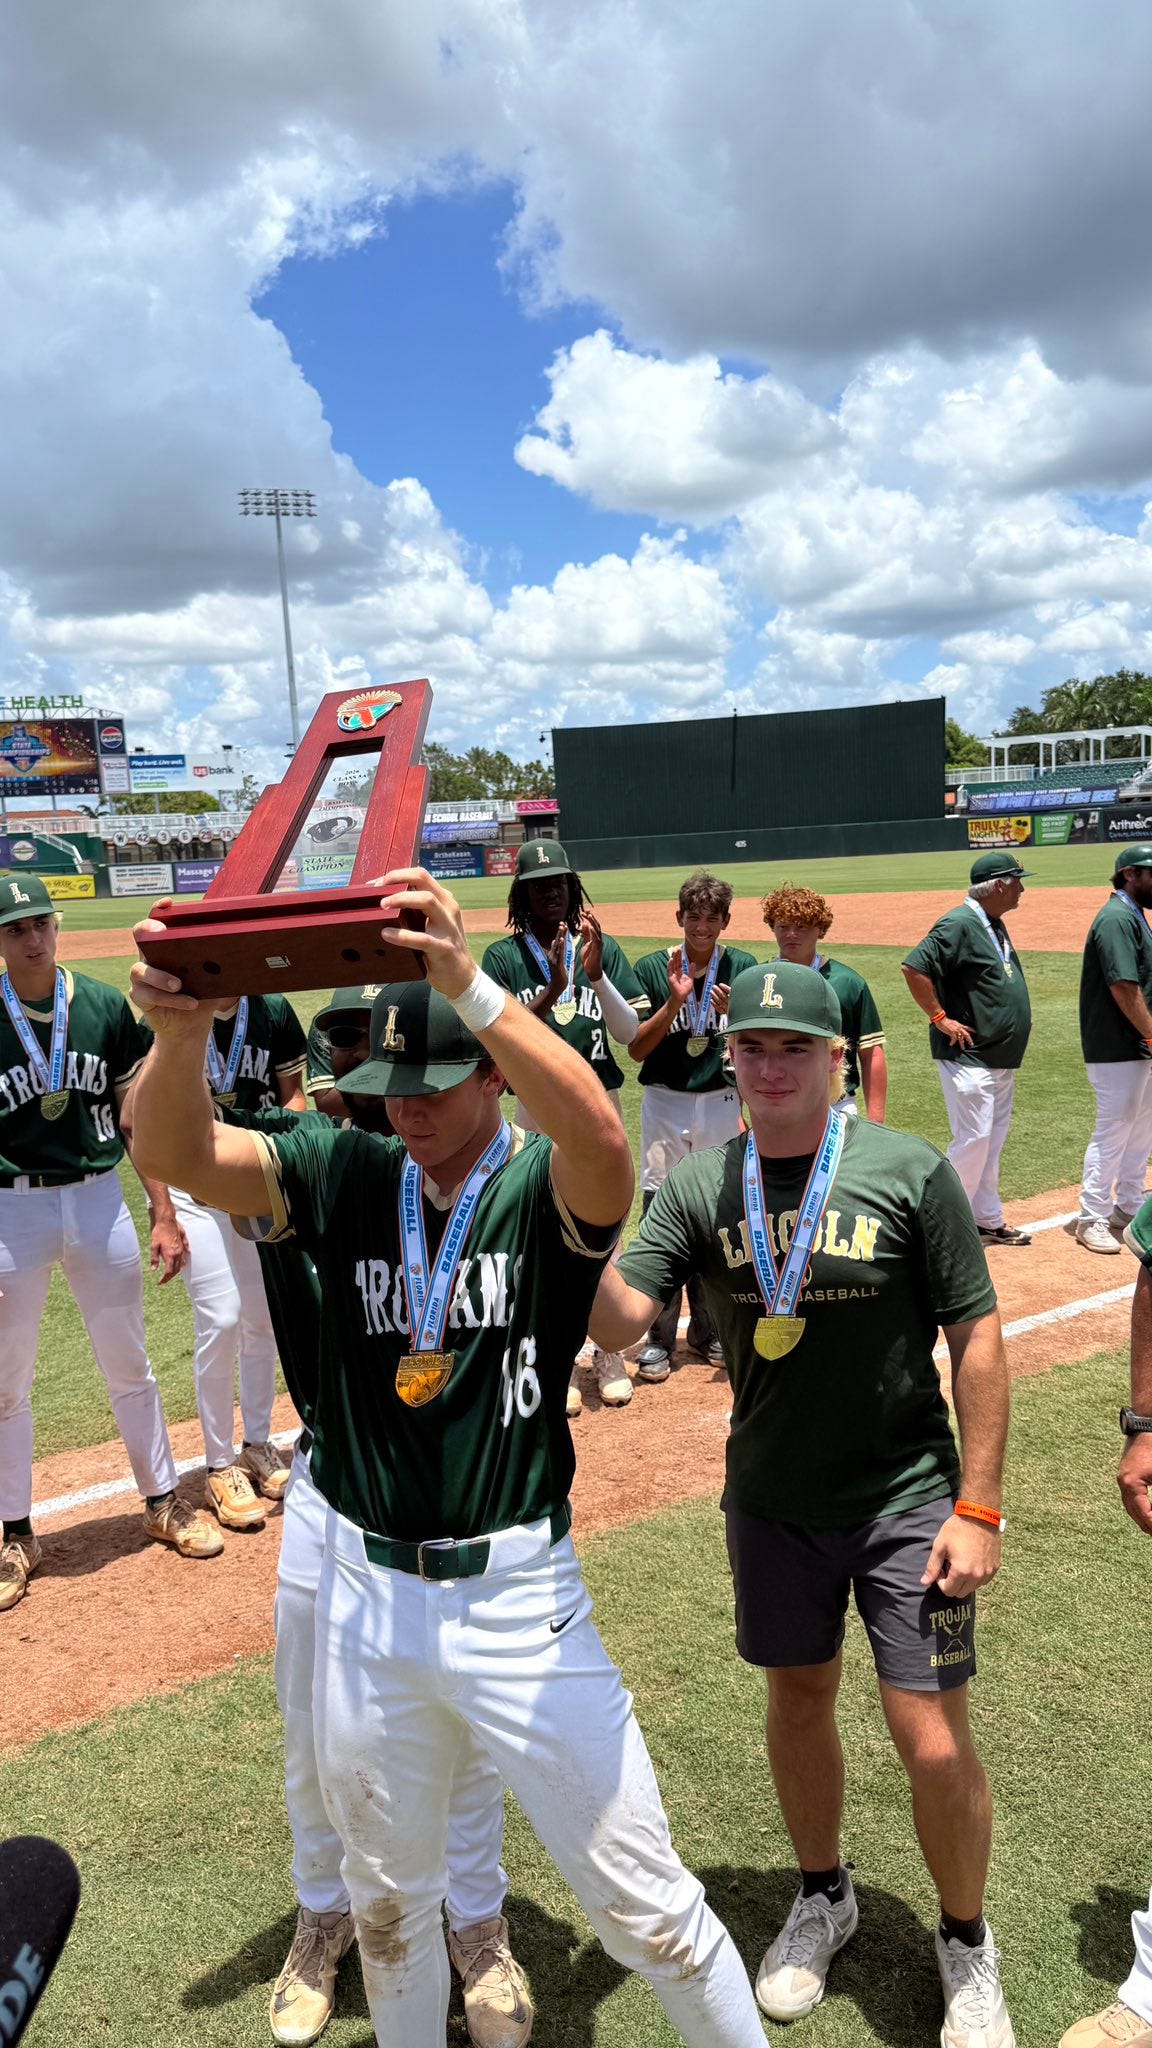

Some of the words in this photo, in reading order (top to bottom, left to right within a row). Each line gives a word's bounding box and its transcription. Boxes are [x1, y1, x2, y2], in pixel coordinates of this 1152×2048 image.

[11, 695, 83, 709] HEALTH
[209, 766, 234, 775] bank
[432, 813, 459, 822] SCHOOL
[460, 812, 494, 822] BASEBALL
[970, 820, 1000, 831] TRULY
[1109, 820, 1147, 830] Arthrex
[136, 834, 148, 842] 42
[161, 833, 167, 841] 3
[183, 832, 188, 840] 6
[222, 830, 231, 838] 14
[304, 855, 336, 864] STATE
[536, 847, 550, 864] L
[177, 868, 213, 878] Massage
[288, 862, 345, 874] CHAMPION
[9, 882, 30, 905] L
[760, 973, 783, 1010] L
[382, 1005, 405, 1052] L
[52, 1047, 62, 1090] BASEBALL
[402, 1164, 418, 1235] BASEBALL
[806, 1191, 820, 1217] FLORIDA
[441, 1192, 476, 1275] BASEBALL
[783, 1270, 796, 1299] FLORIDA
[428, 1296, 440, 1330] FLORIDA
[929, 1603, 972, 1630] TROJAN
[930, 1646, 972, 1667] BASEBALL
